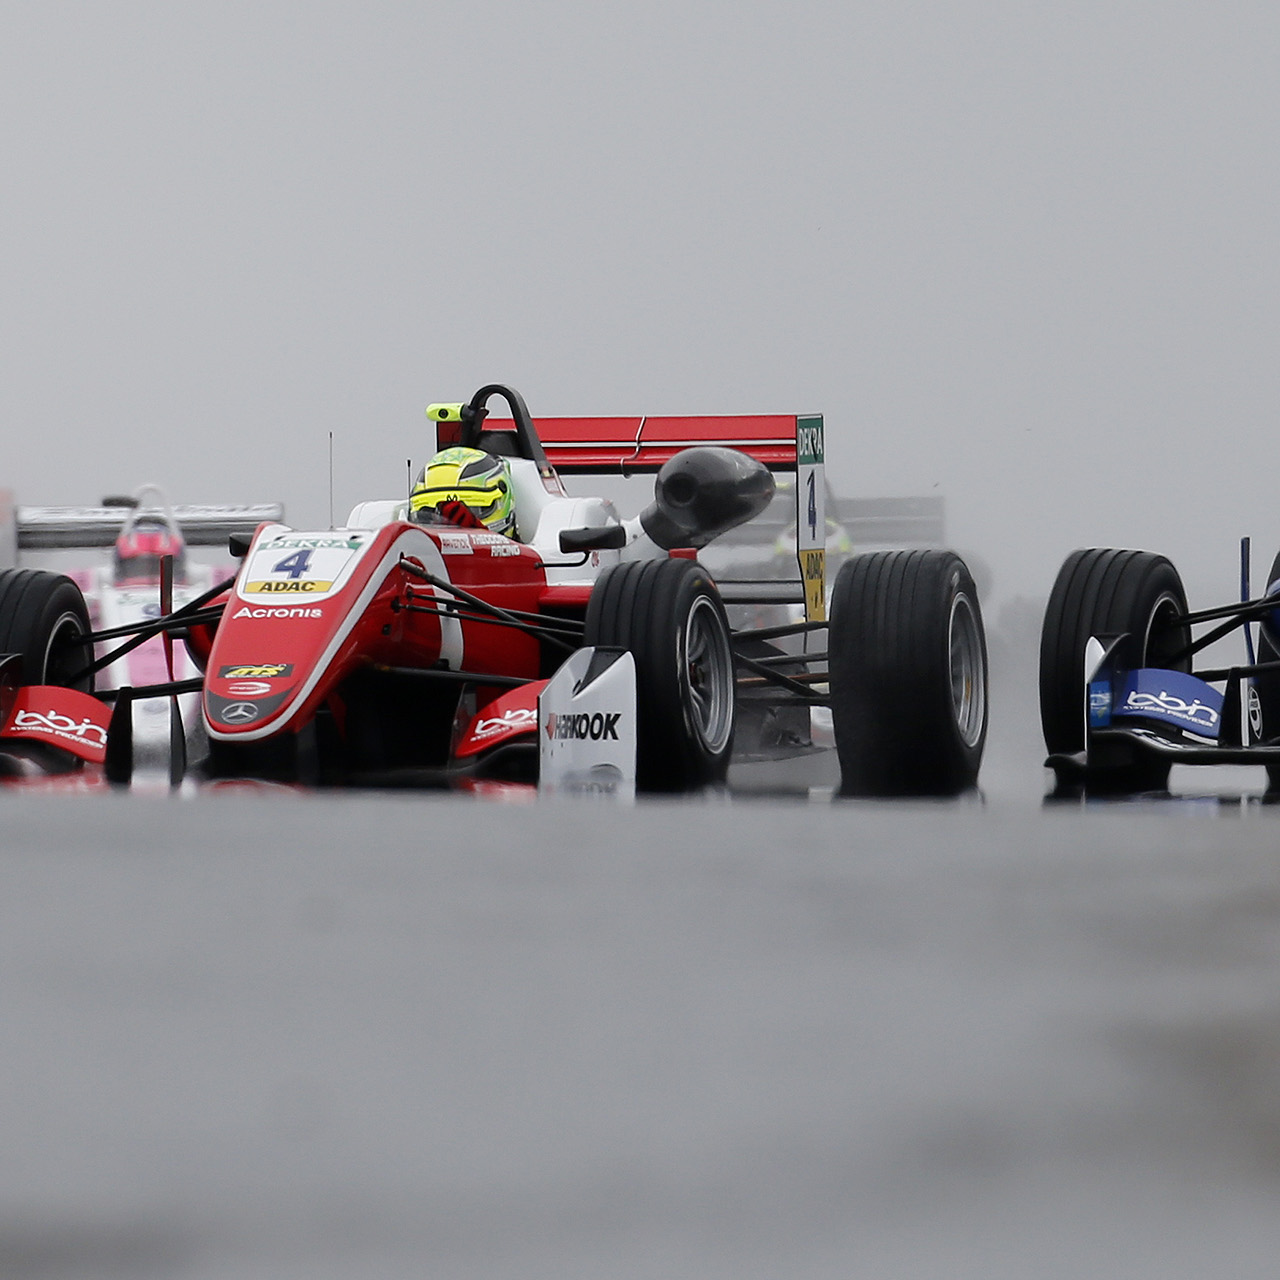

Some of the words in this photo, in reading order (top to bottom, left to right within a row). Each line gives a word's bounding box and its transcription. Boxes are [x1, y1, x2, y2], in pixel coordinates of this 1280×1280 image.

[799, 427, 823, 456] DEKRA
[265, 540, 349, 549] DEKRA
[272, 549, 315, 579] 4
[259, 581, 315, 592] ADAC
[233, 607, 322, 619] Acronis
